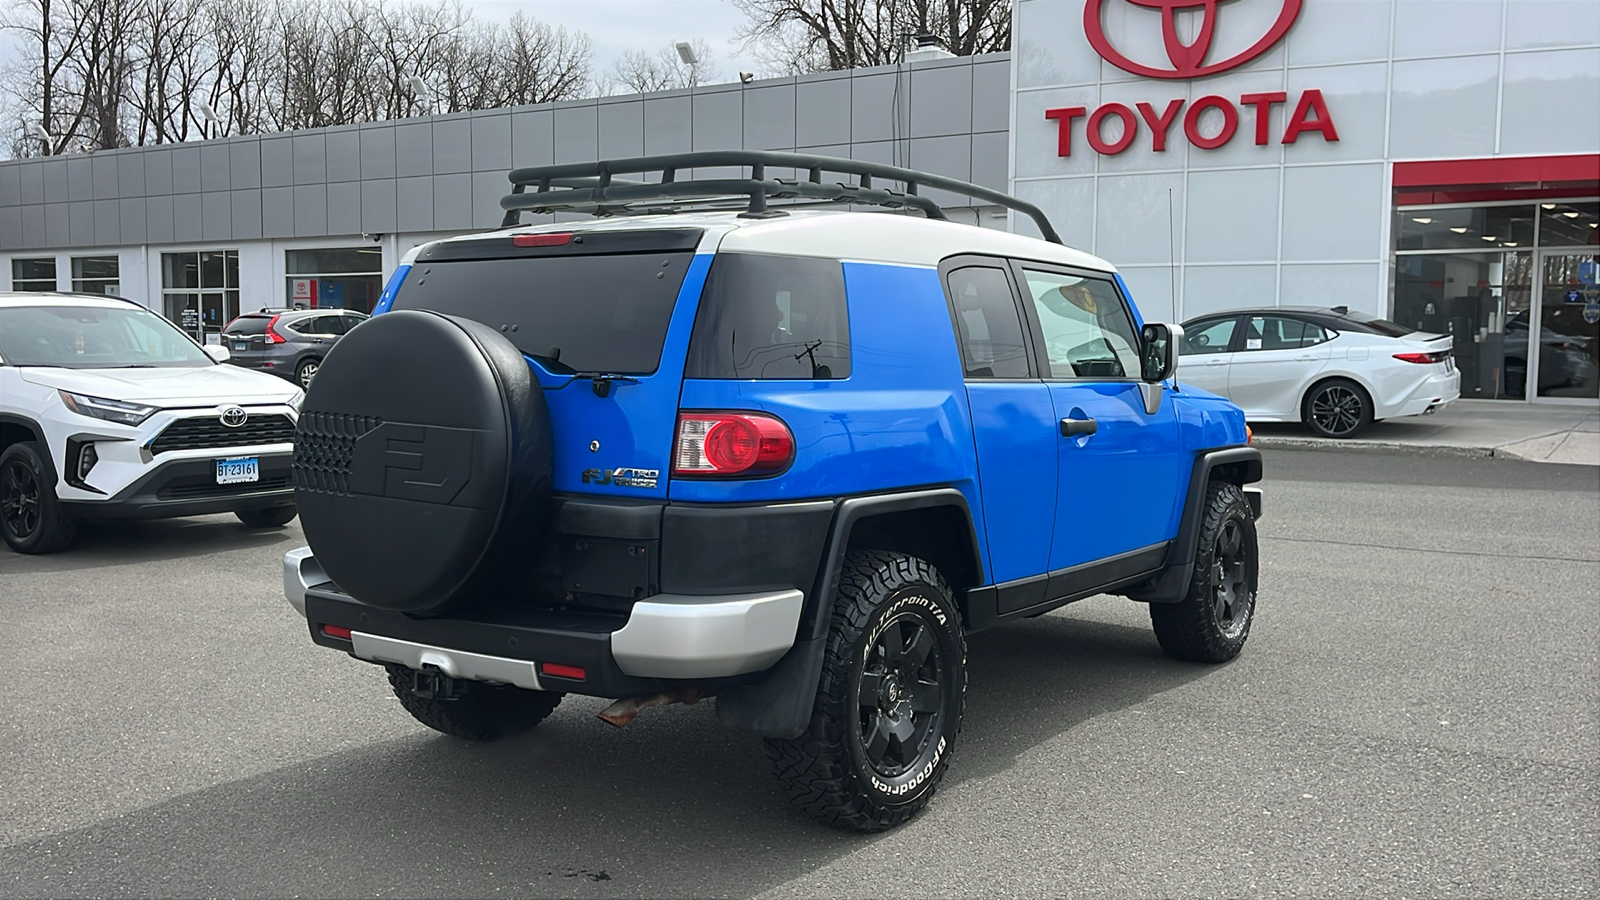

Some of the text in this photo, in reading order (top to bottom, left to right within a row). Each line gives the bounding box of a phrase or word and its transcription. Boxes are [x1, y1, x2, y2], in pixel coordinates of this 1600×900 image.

[1045, 89, 1340, 157] TOYOTA
[582, 468, 613, 484] FJ
[631, 468, 660, 478] TRD
[863, 594, 947, 661] All-Terrain T/A
[871, 735, 947, 796] BFGoodrich
